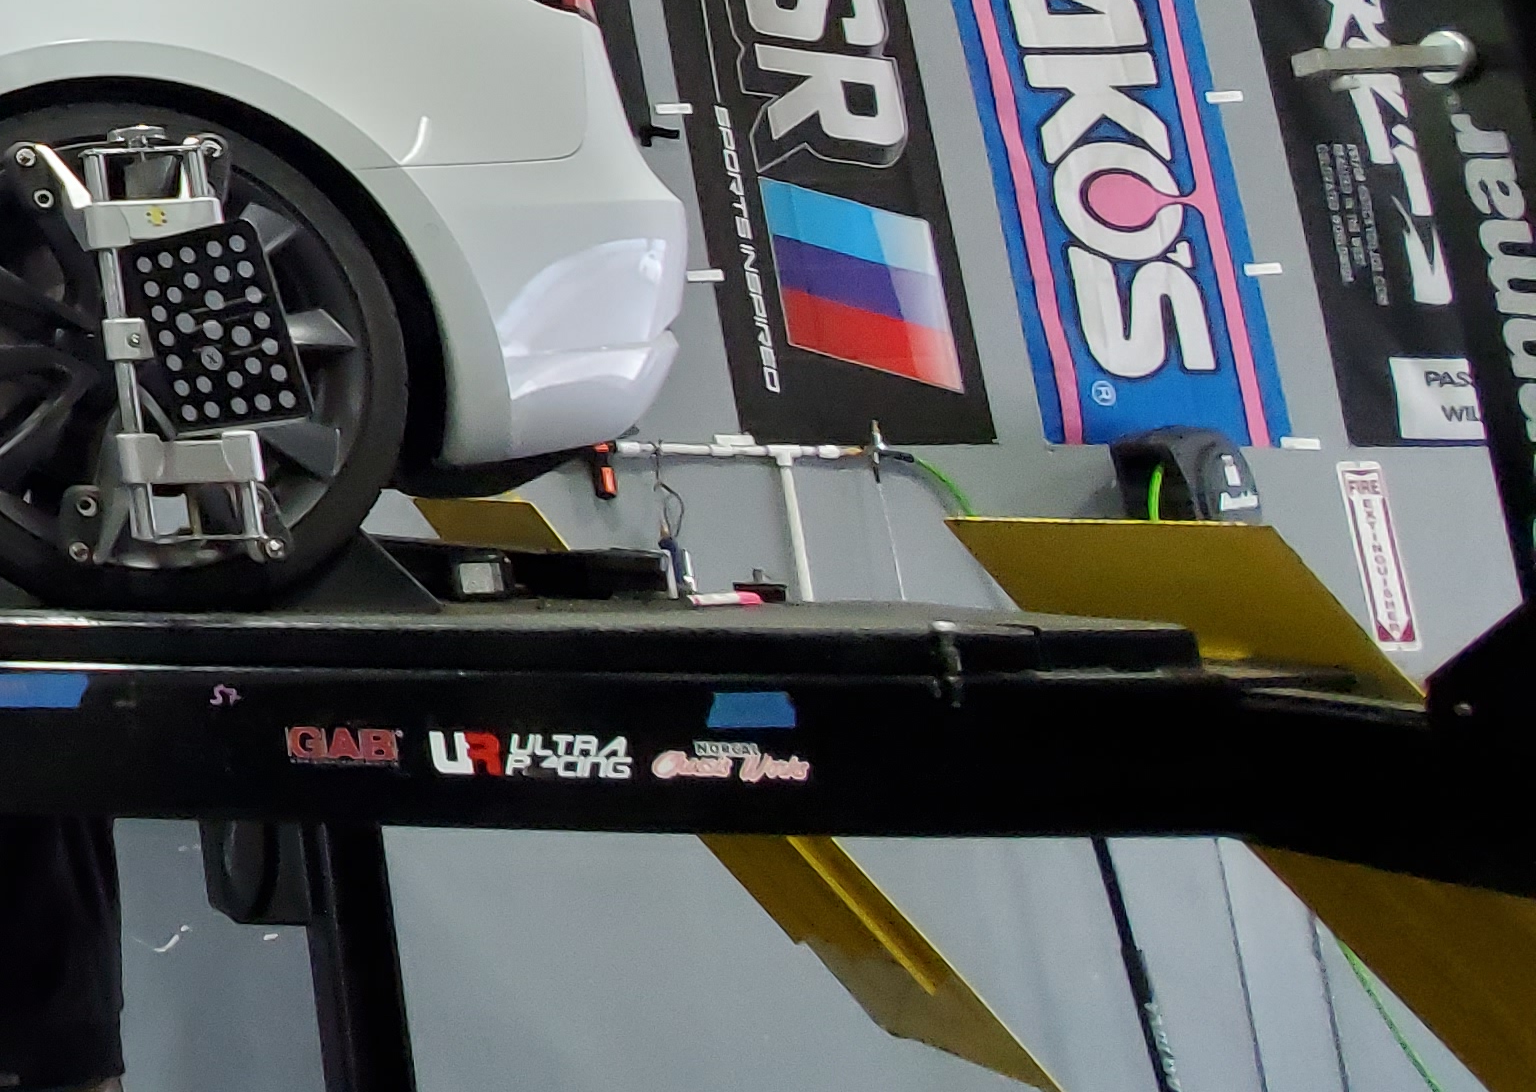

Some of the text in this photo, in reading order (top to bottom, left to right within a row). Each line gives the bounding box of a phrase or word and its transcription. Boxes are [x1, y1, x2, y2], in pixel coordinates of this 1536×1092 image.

[714, 104, 781, 393] SPORTS INSPIRED
[1348, 479, 1381, 496] FIRE
[285, 725, 399, 762] GAB
[428, 729, 505, 777] UR
[510, 732, 628, 758] ULTRA
